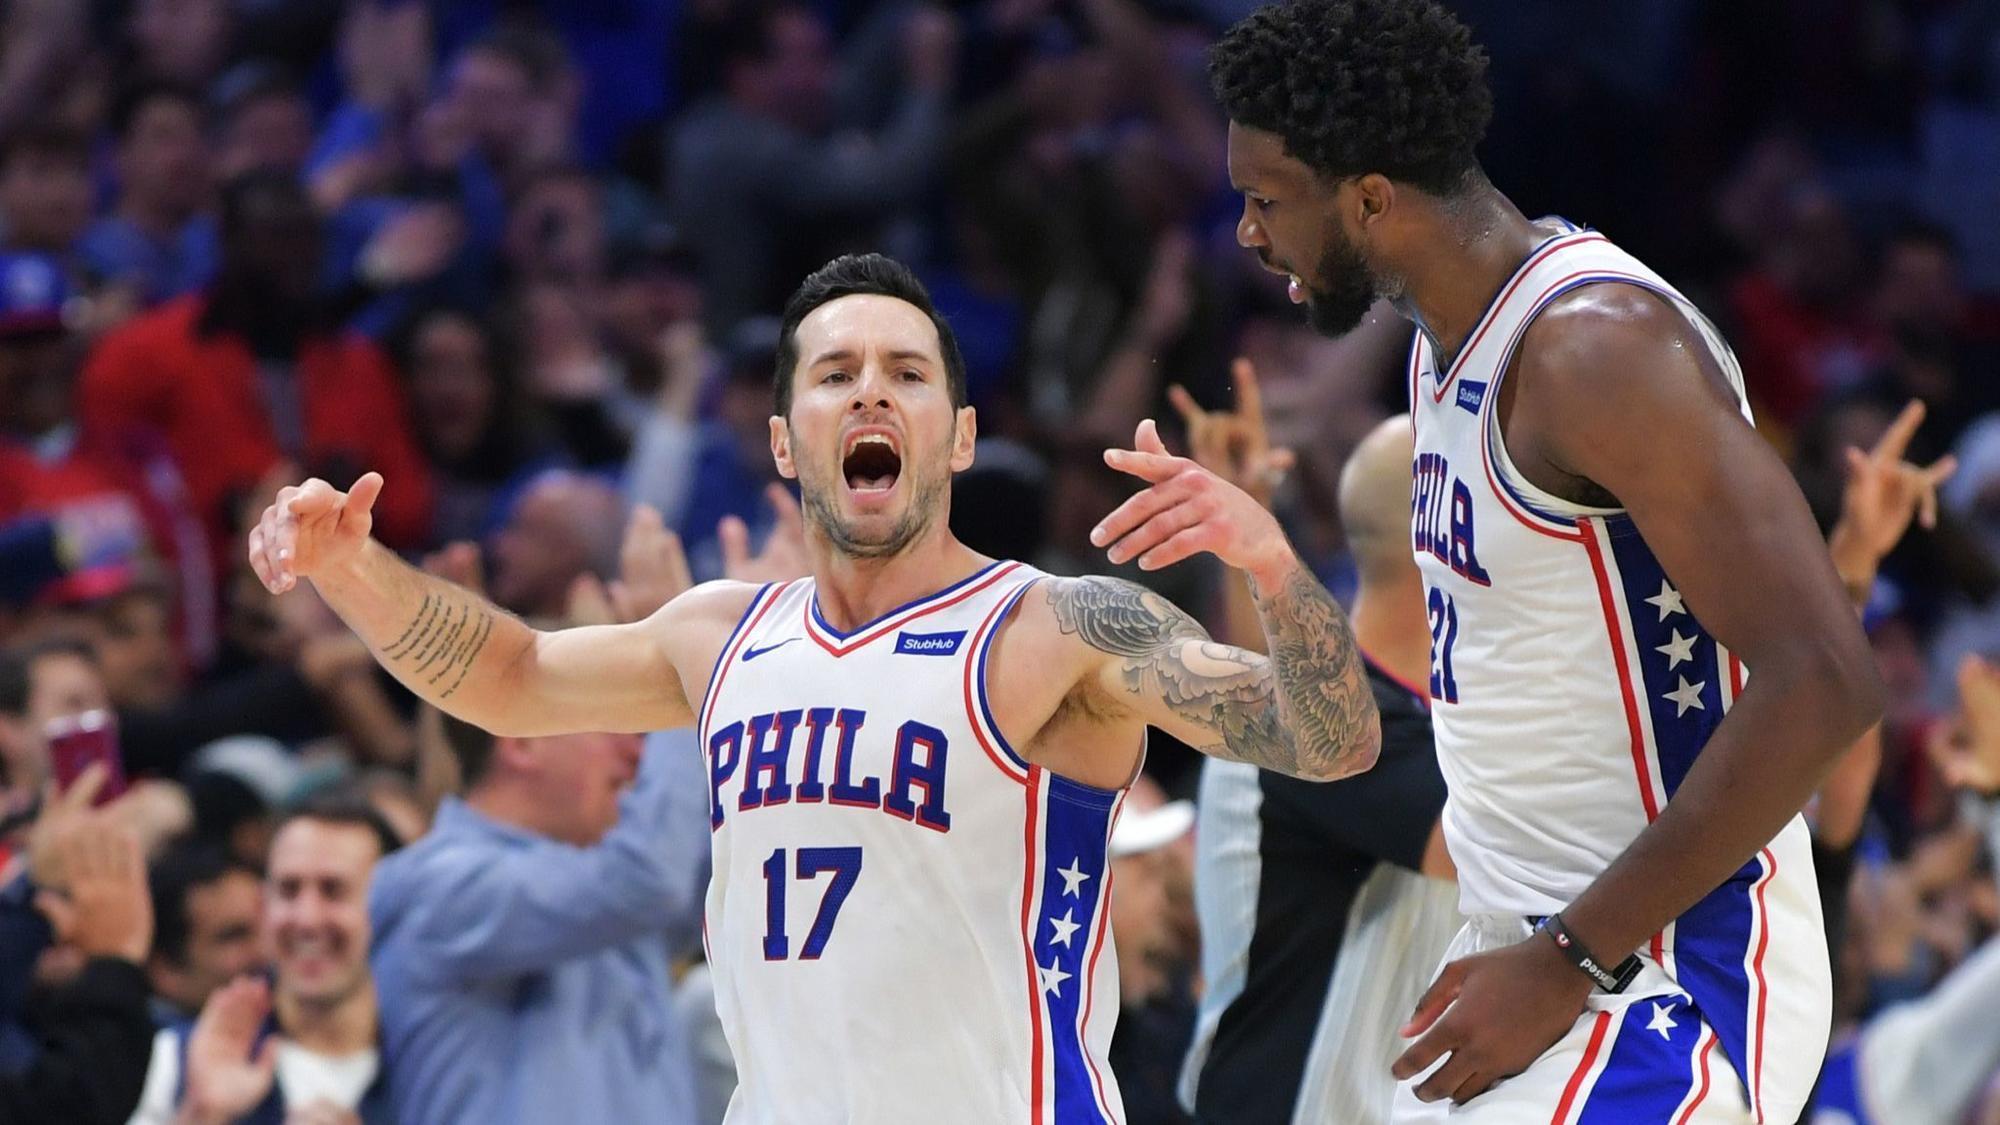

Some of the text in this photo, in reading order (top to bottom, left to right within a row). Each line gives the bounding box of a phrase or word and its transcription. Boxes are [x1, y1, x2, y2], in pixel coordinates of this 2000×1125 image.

[903, 638, 955, 650] StubHub
[1428, 586, 1459, 704] 21
[709, 707, 951, 834] PHILA
[763, 846, 863, 961] 17
[1579, 958, 1609, 981] ssed
